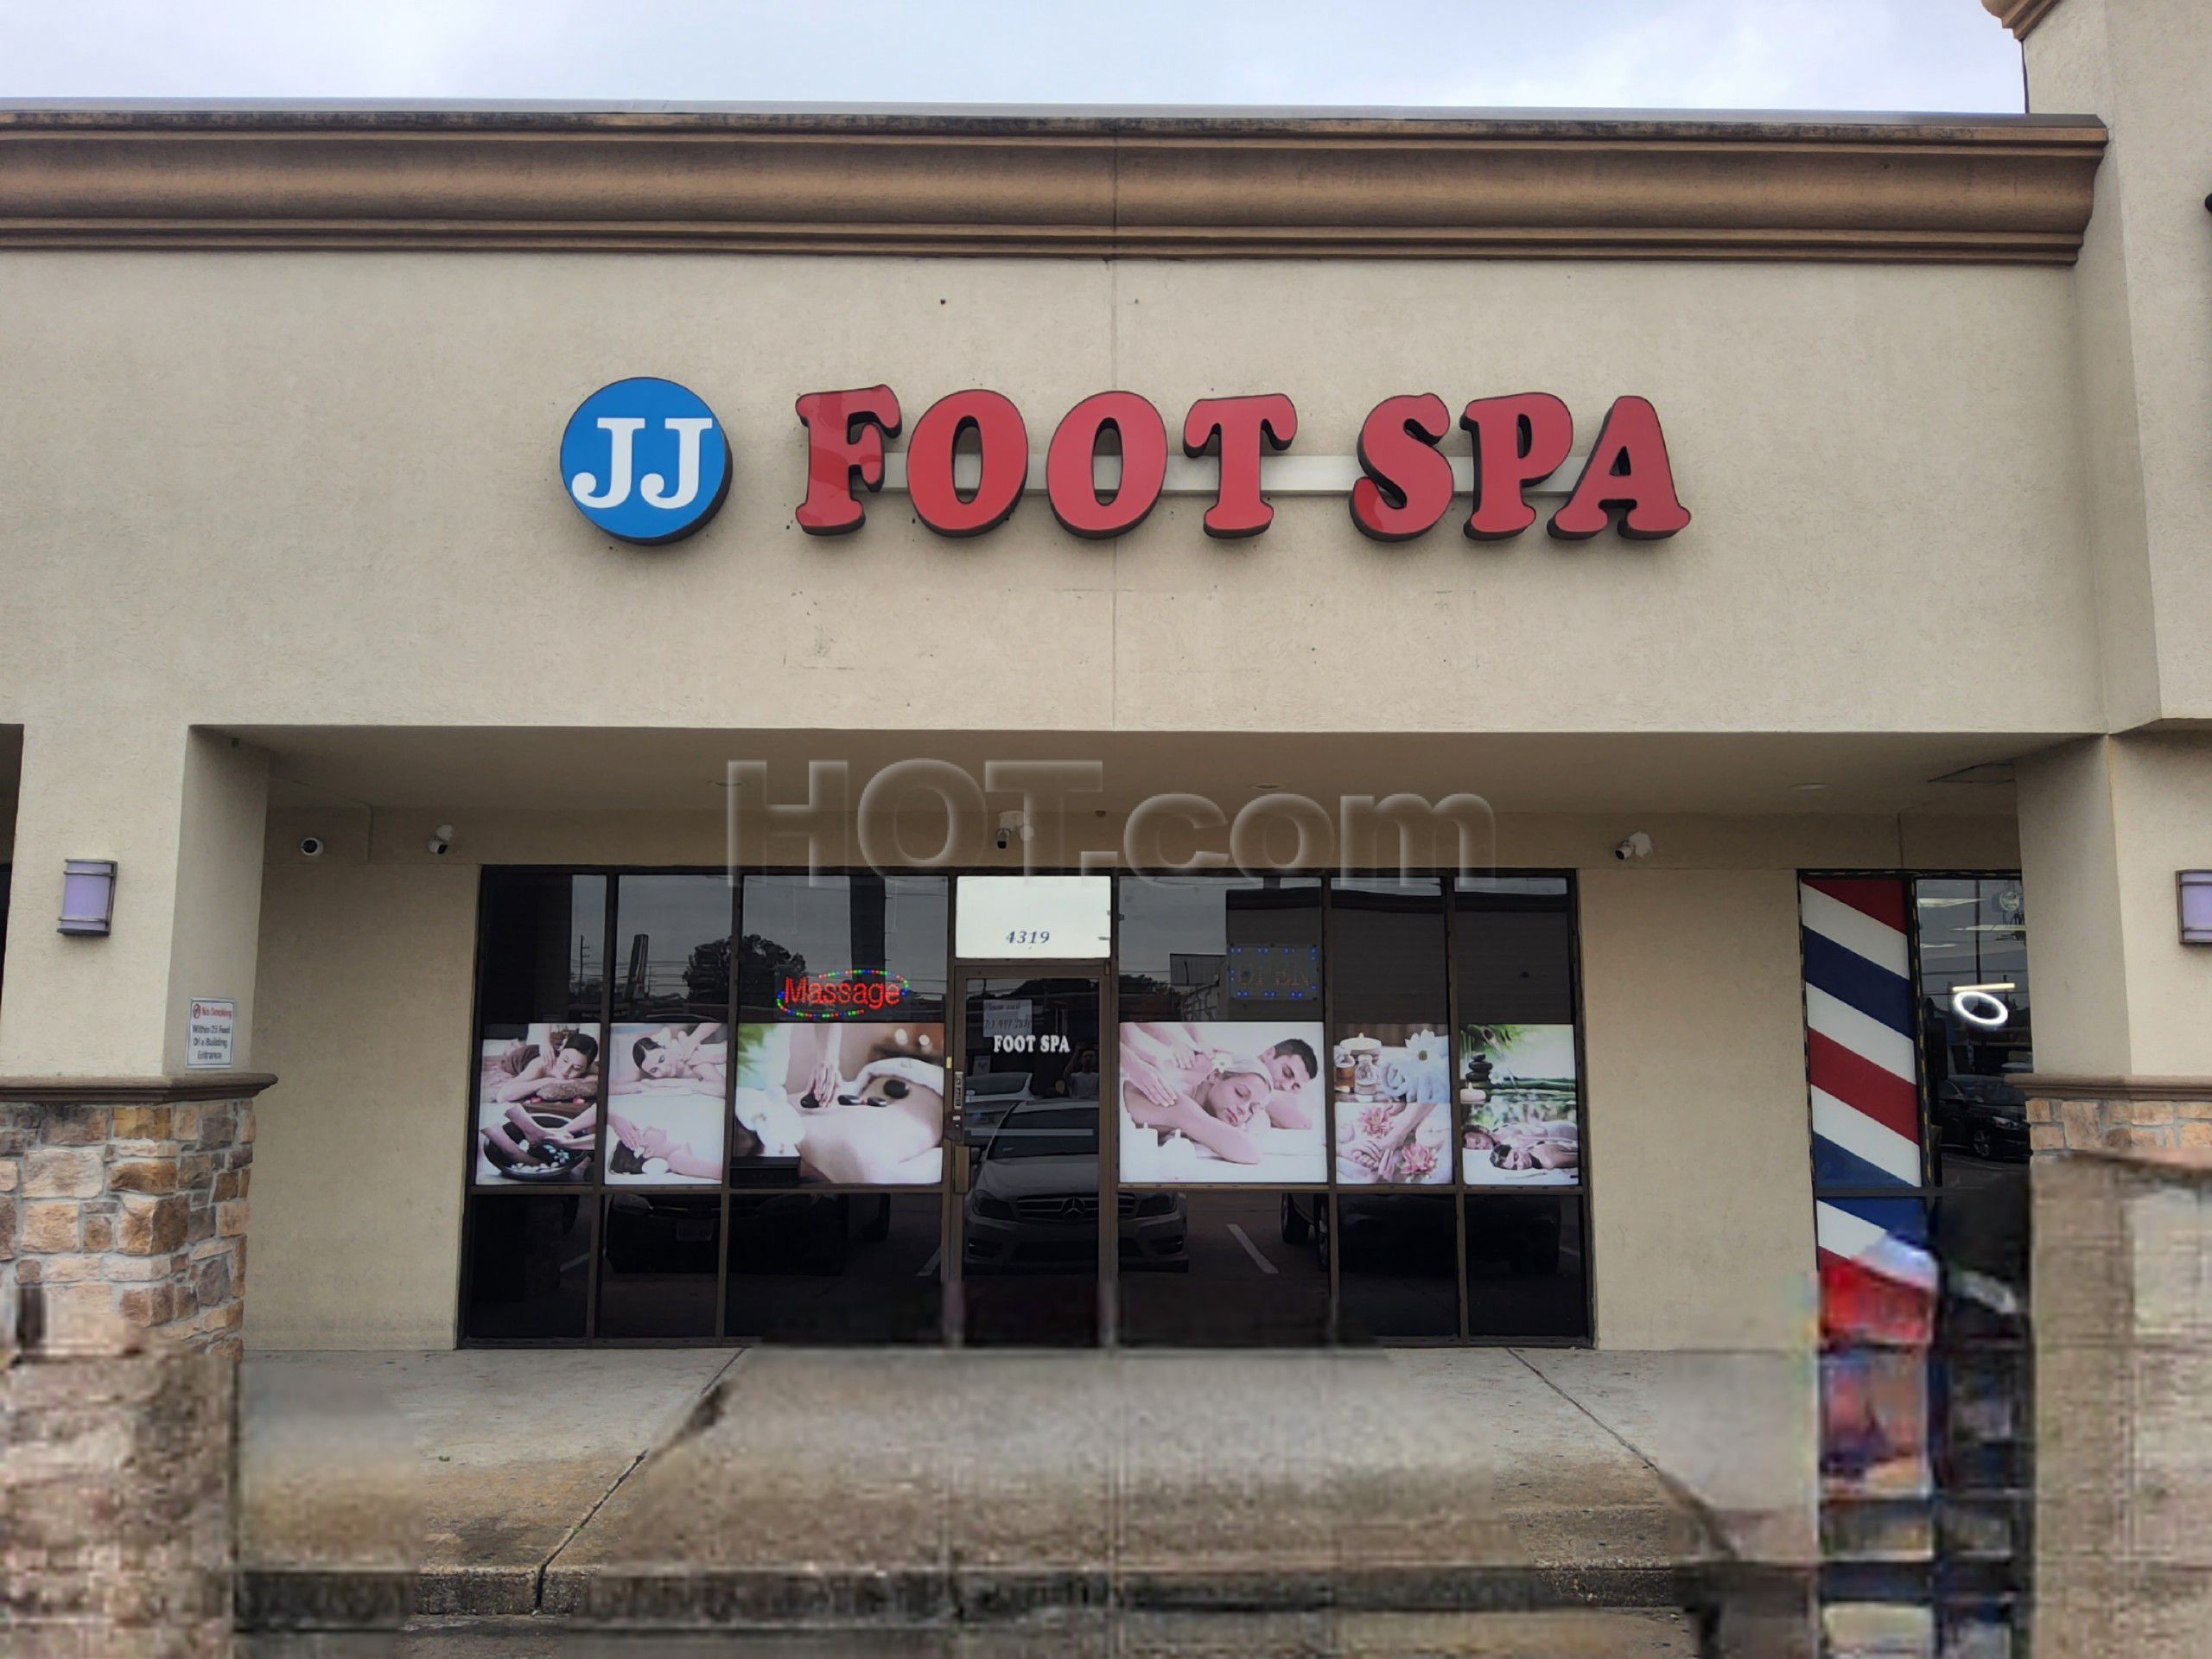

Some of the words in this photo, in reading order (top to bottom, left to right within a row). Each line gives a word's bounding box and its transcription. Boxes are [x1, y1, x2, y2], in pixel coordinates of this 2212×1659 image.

[572, 417, 713, 509] JJ
[795, 385, 1298, 539] FOOT
[1350, 392, 1691, 542] SPA
[1006, 931, 1051, 944] 4319
[784, 976, 900, 1009] Massage
[197, 1051, 222, 1059] Entrance
[994, 1034, 1036, 1053] FOOT
[1040, 1034, 1071, 1053] SPA
